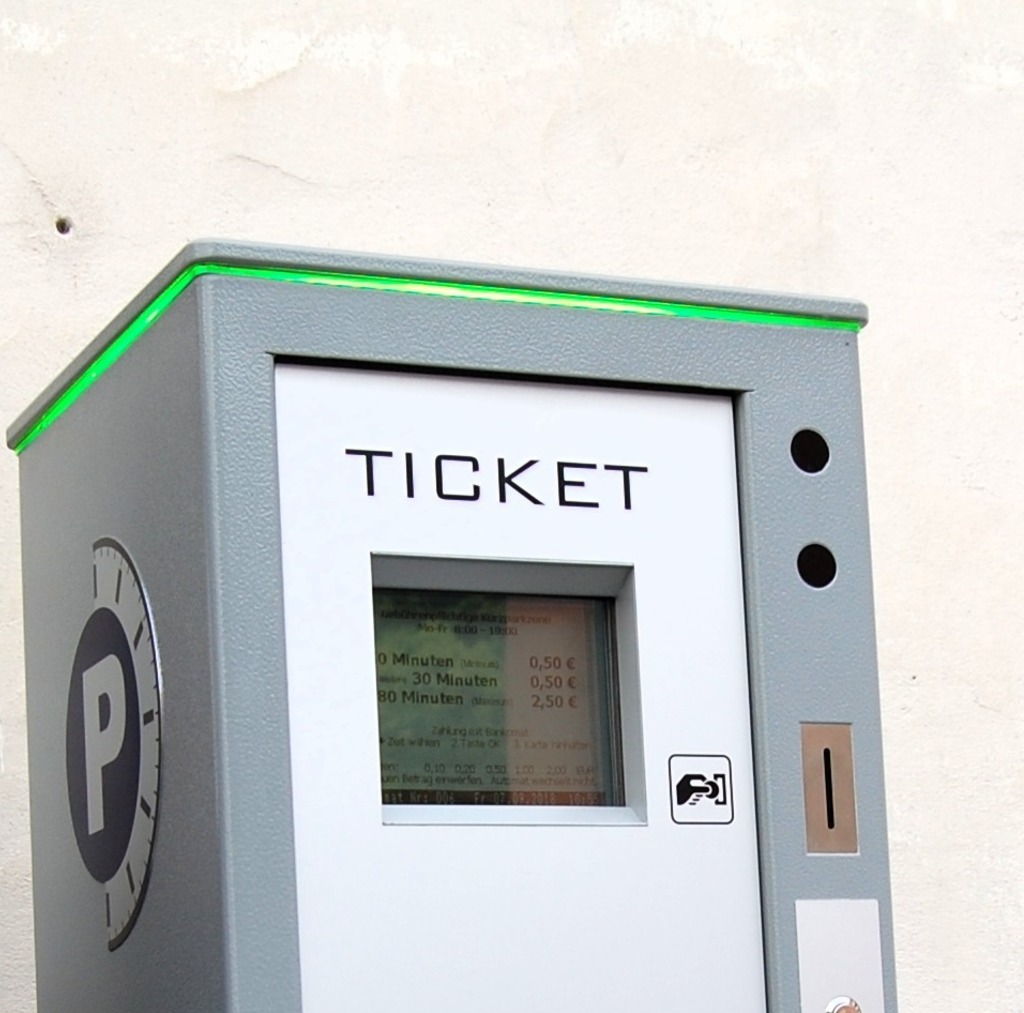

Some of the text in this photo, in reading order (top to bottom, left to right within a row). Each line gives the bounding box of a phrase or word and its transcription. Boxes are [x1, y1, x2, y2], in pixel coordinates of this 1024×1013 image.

[345, 448, 648, 510] TICKET
[392, 653, 454, 667] Minuten
[529, 656, 561, 671] 0,50
[567, 657, 576, 669] €
[412, 672, 431, 685] 30
[437, 673, 498, 687] Minuten
[530, 676, 562, 691] 0,50
[567, 676, 576, 689] €
[402, 691, 463, 705] Minuten
[531, 695, 563, 710] 2,50
[568, 696, 577, 708] €
[82, 653, 126, 835] P
